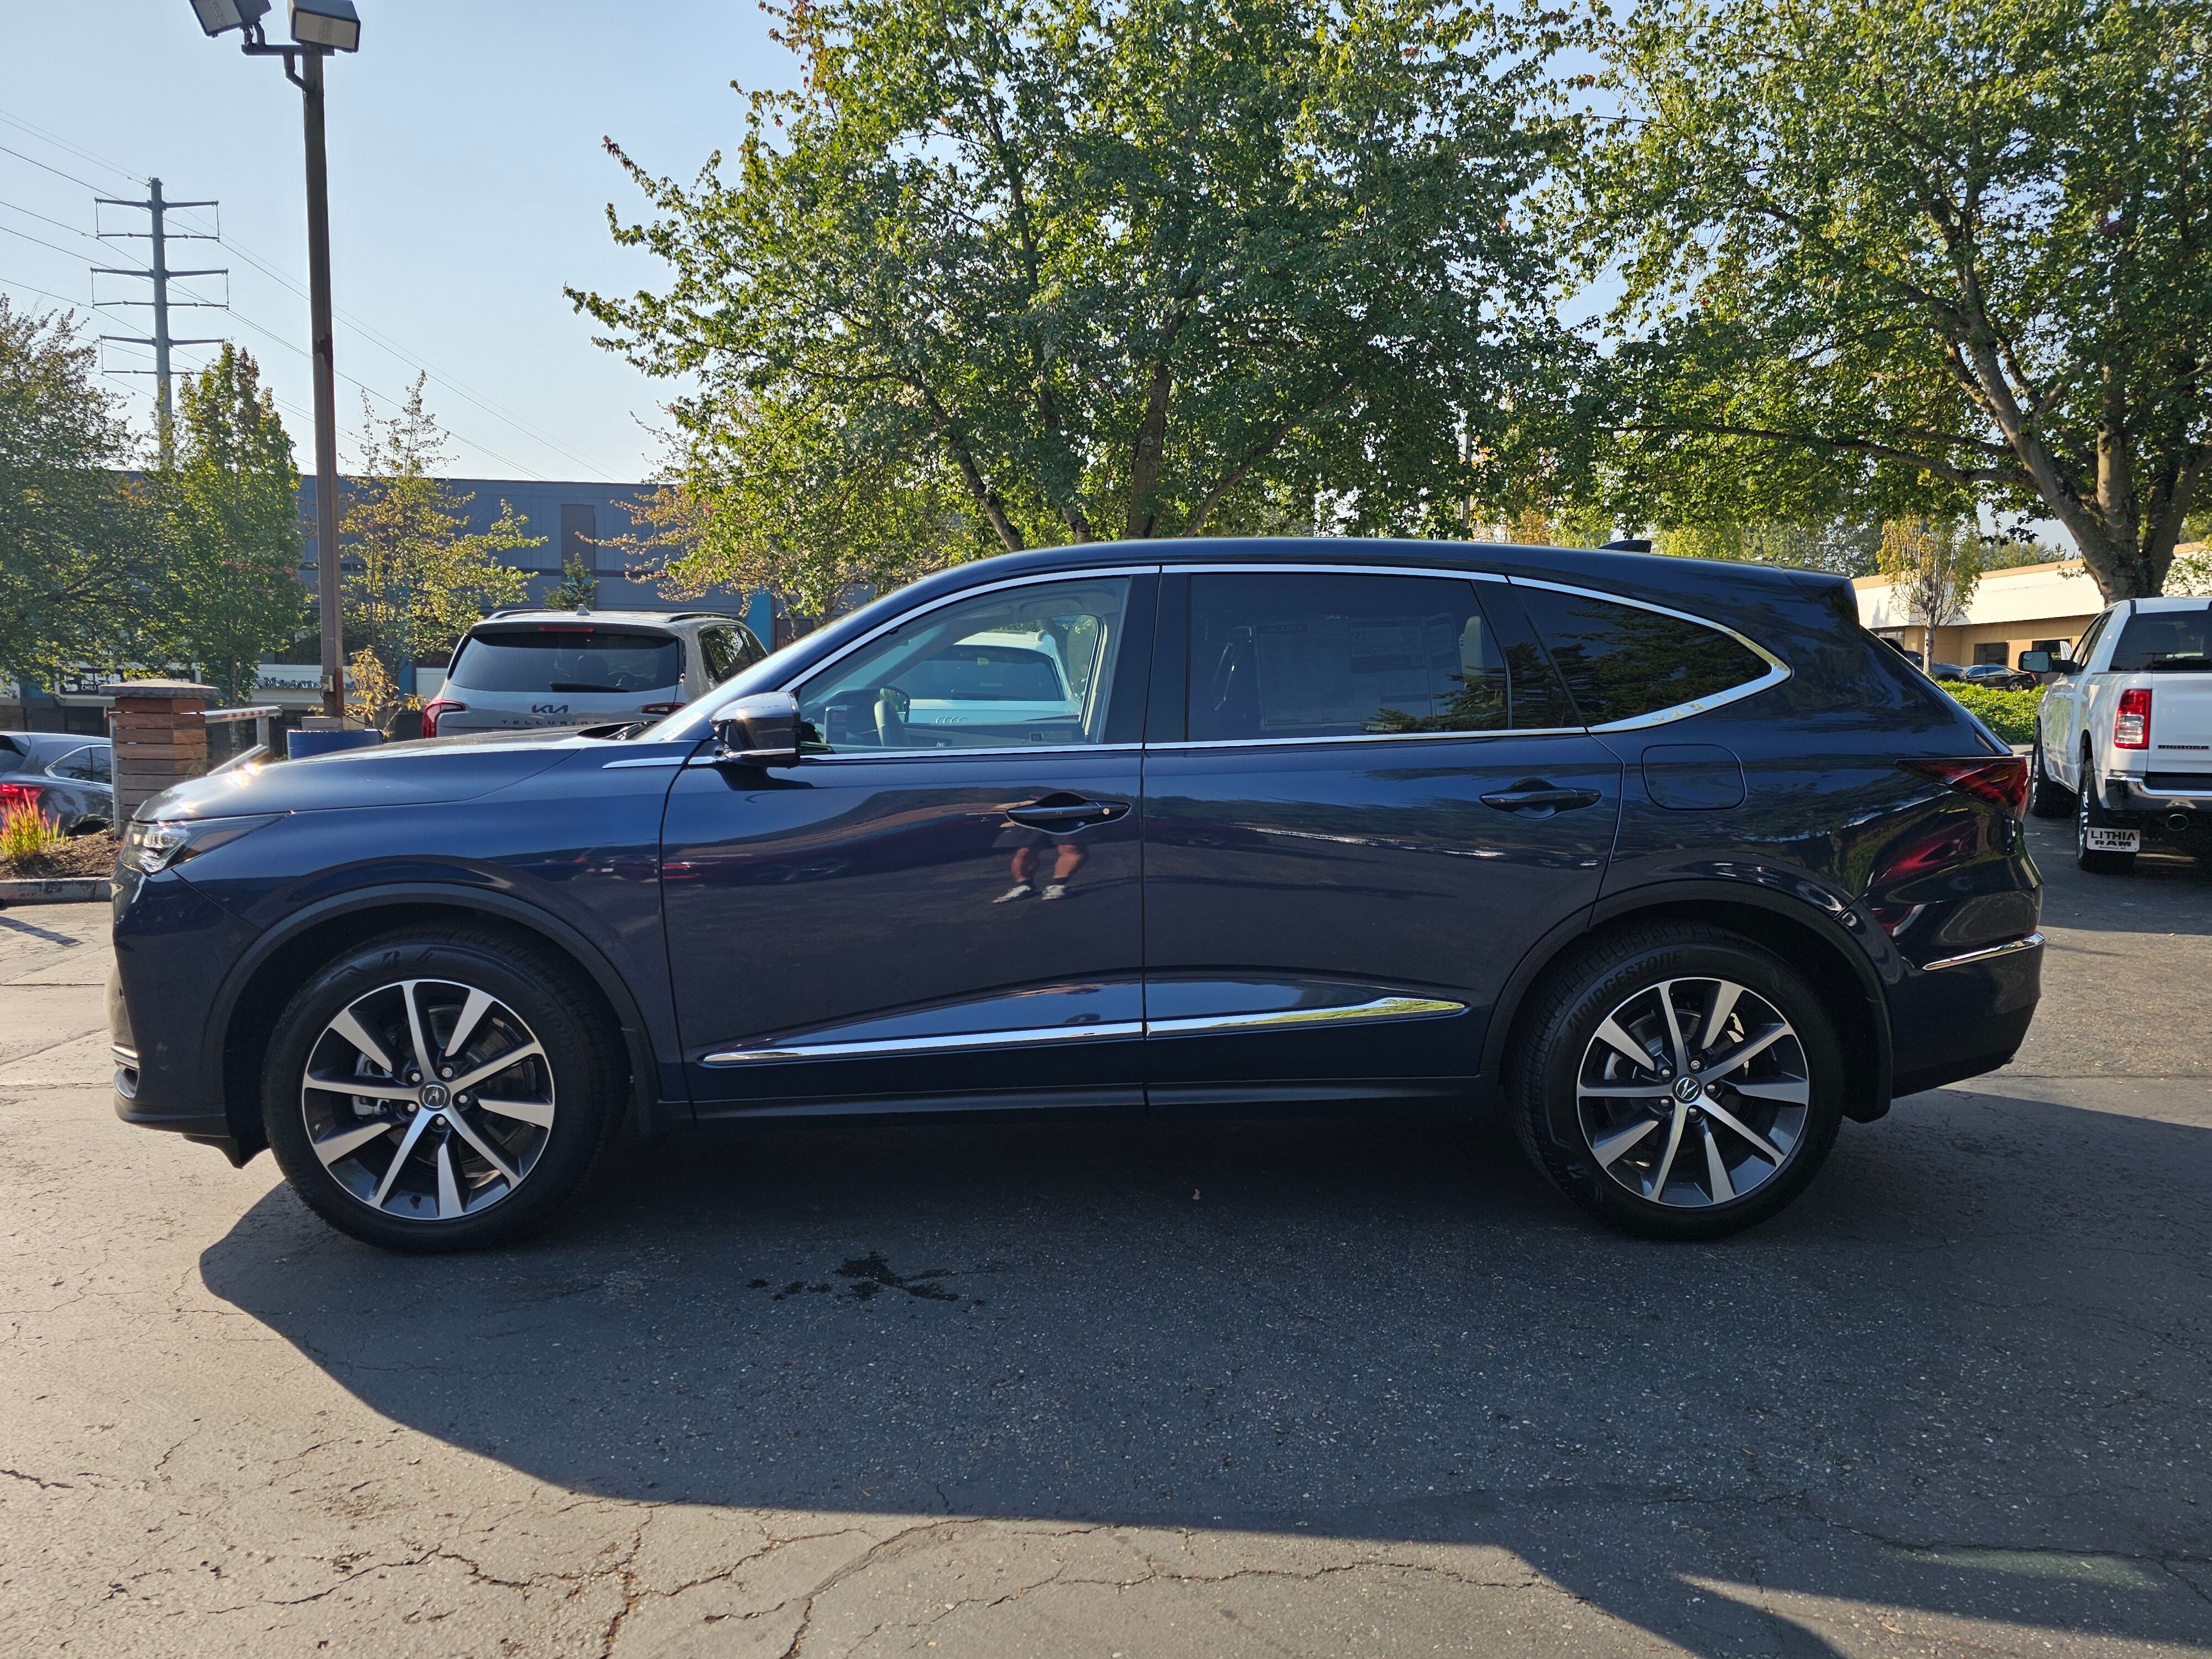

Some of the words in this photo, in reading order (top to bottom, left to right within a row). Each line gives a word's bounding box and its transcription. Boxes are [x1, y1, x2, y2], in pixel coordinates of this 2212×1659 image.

[263, 676, 300, 690] Melody
[531, 704, 568, 714] KIA
[2091, 831, 2136, 841] LITHIA
[1567, 950, 1683, 1030] BRIDGESTONE
